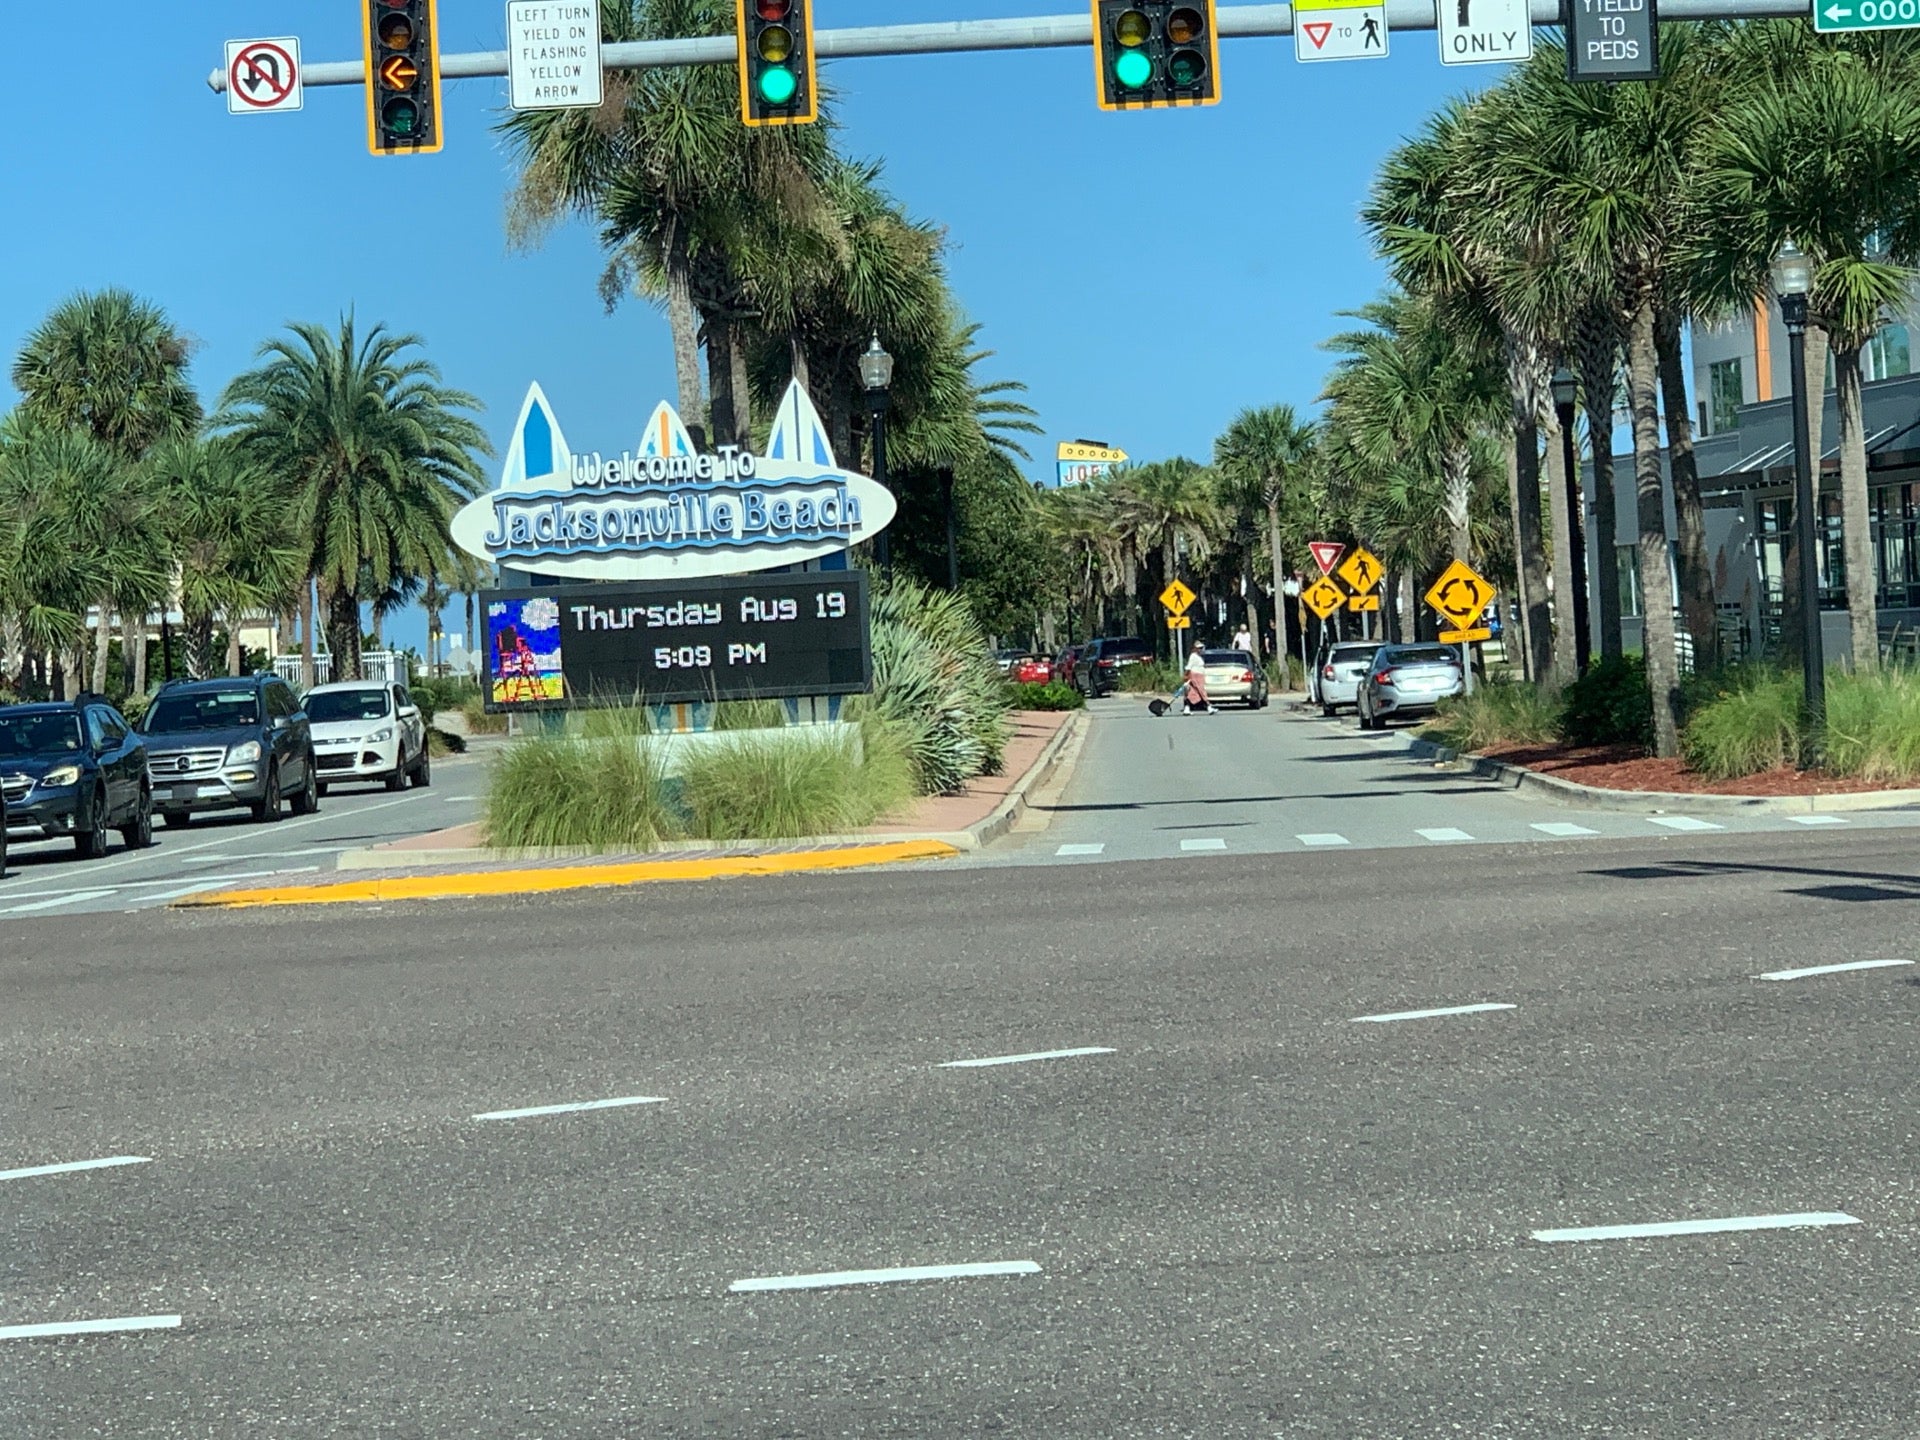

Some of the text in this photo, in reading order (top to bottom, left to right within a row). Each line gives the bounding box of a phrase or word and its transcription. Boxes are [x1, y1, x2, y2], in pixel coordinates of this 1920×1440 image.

[516, 7, 590, 22] LEFT TURN
[1584, 0, 1643, 13] YIELD
[523, 26, 586, 41] YIELD ON
[1336, 27, 1353, 38] TO
[1599, 16, 1626, 37] TO
[1453, 31, 1518, 54] ONLY
[1587, 40, 1640, 61] PEDS
[523, 45, 587, 60] FLASHING
[529, 65, 582, 79] YELLOW
[534, 85, 579, 99] ARROW
[570, 444, 755, 488] Welcome To
[484, 486, 863, 548] Jacksonville Beach
[570, 591, 847, 633] Thursday Aug 19
[654, 642, 767, 670] 5:09 PM
